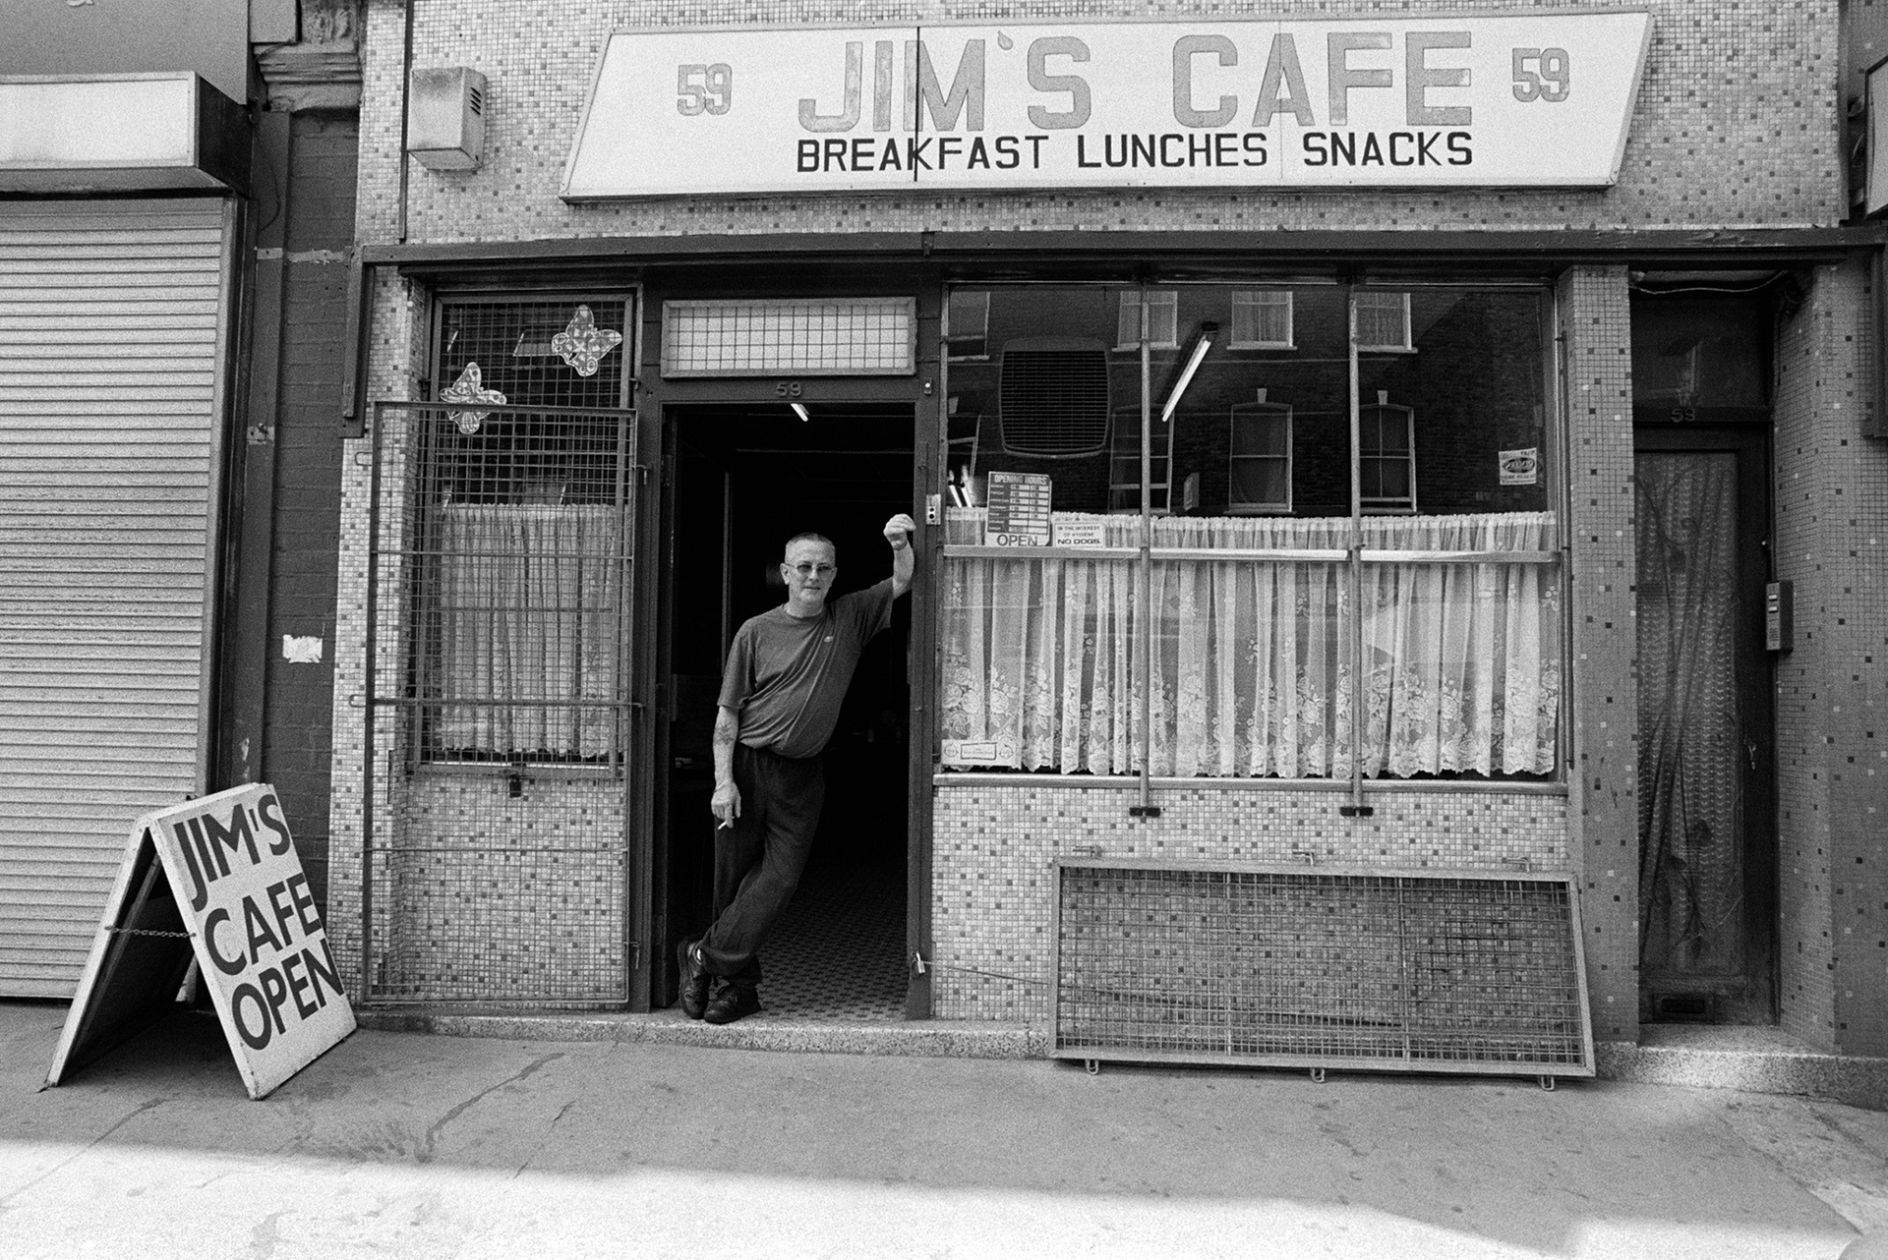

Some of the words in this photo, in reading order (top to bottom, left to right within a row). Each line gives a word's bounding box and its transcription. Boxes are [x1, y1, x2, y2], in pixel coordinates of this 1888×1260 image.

[677, 63, 733, 116] 59
[799, 31, 1092, 132] JIM'S
[1172, 31, 1472, 128] CAFE
[1512, 48, 1570, 102] 59
[797, 135, 1049, 172] BREAKFAST
[1077, 133, 1268, 168] LUNCHES
[1303, 132, 1473, 167] SNACKS
[776, 382, 801, 397] 59
[996, 534, 1039, 546] OPEN
[174, 794, 291, 912] JIM'S
[204, 872, 322, 976] CAFE
[231, 938, 345, 1051] OPEN
